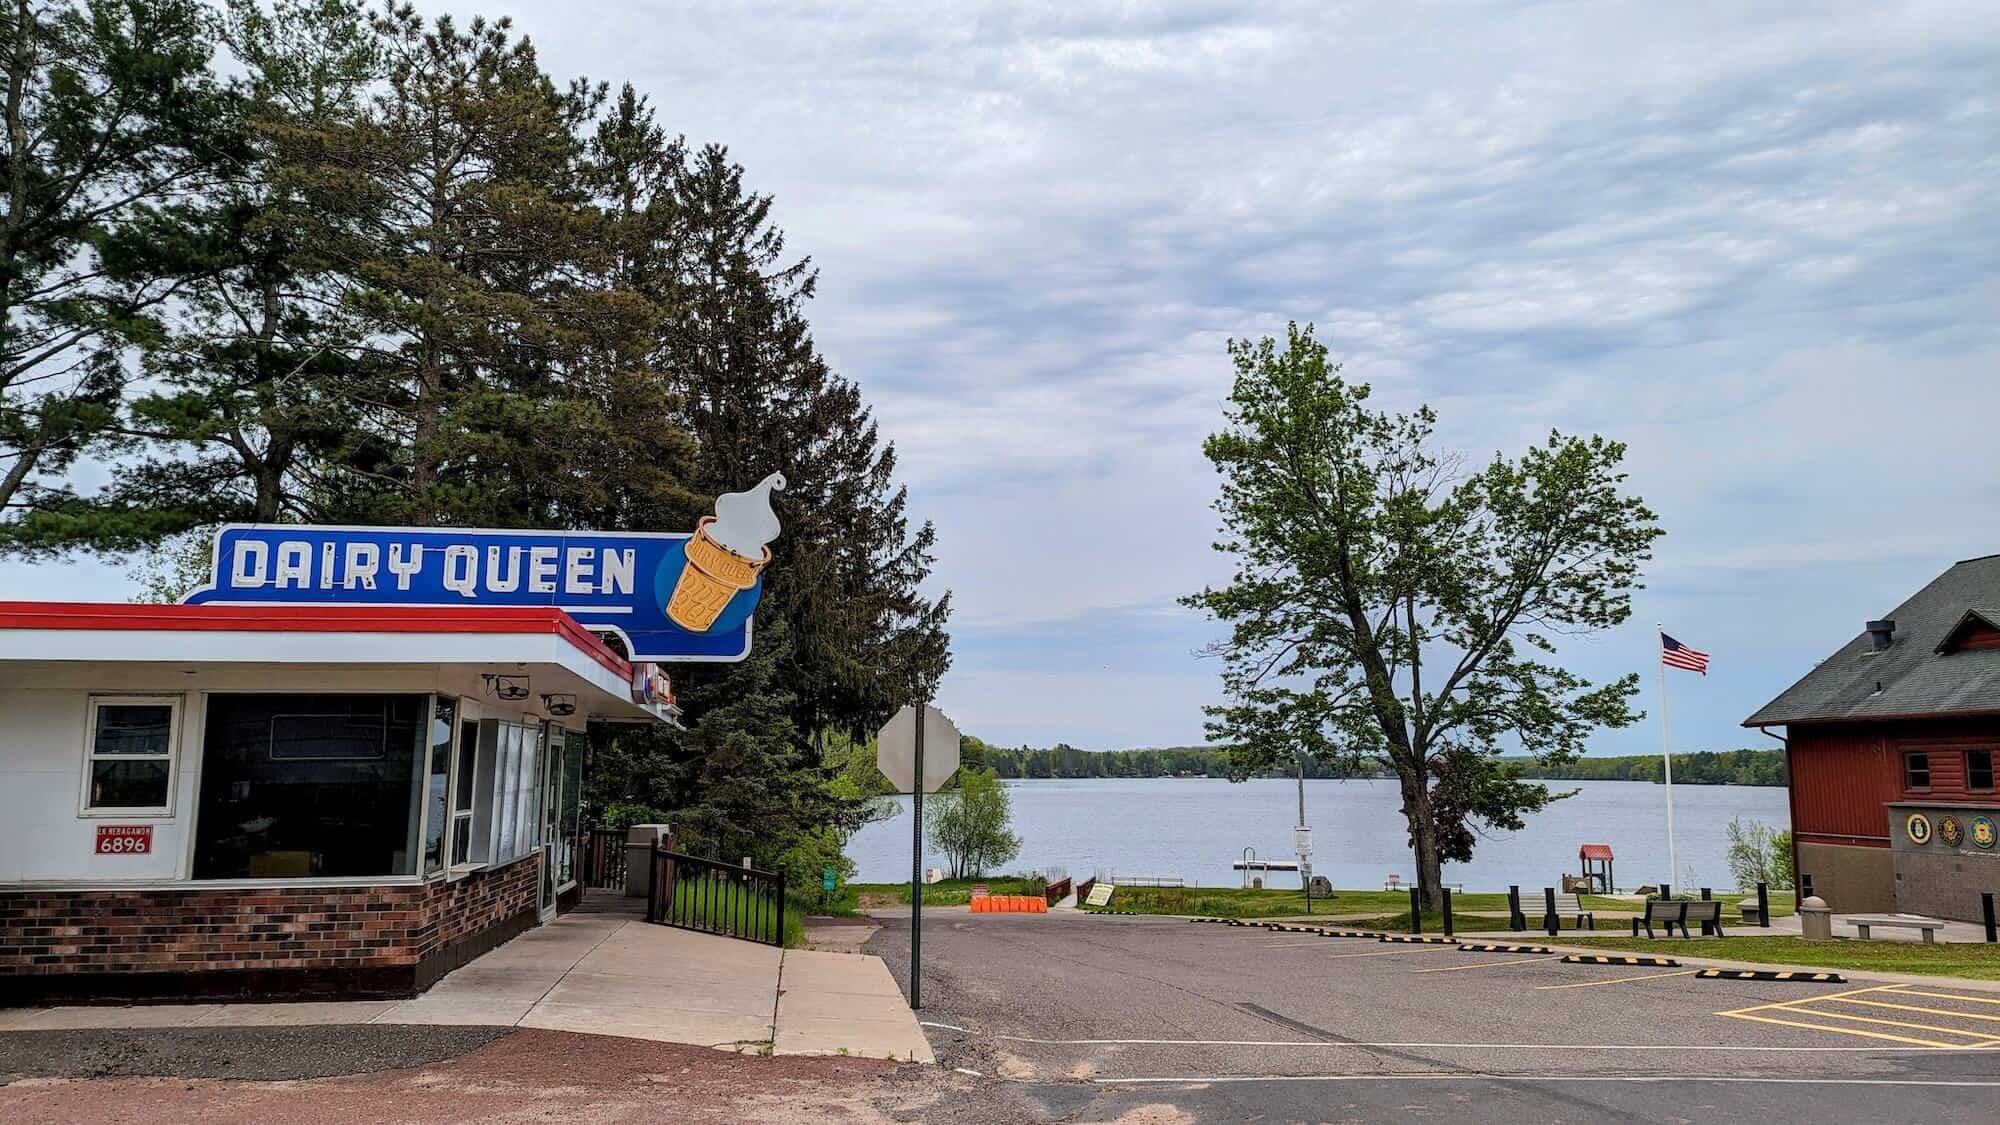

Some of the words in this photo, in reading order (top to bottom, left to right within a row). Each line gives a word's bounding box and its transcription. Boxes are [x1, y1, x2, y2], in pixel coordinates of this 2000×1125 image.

[231, 540, 423, 591] DAIRY
[443, 544, 635, 598] QUEEN
[101, 837, 145, 852] 6896
